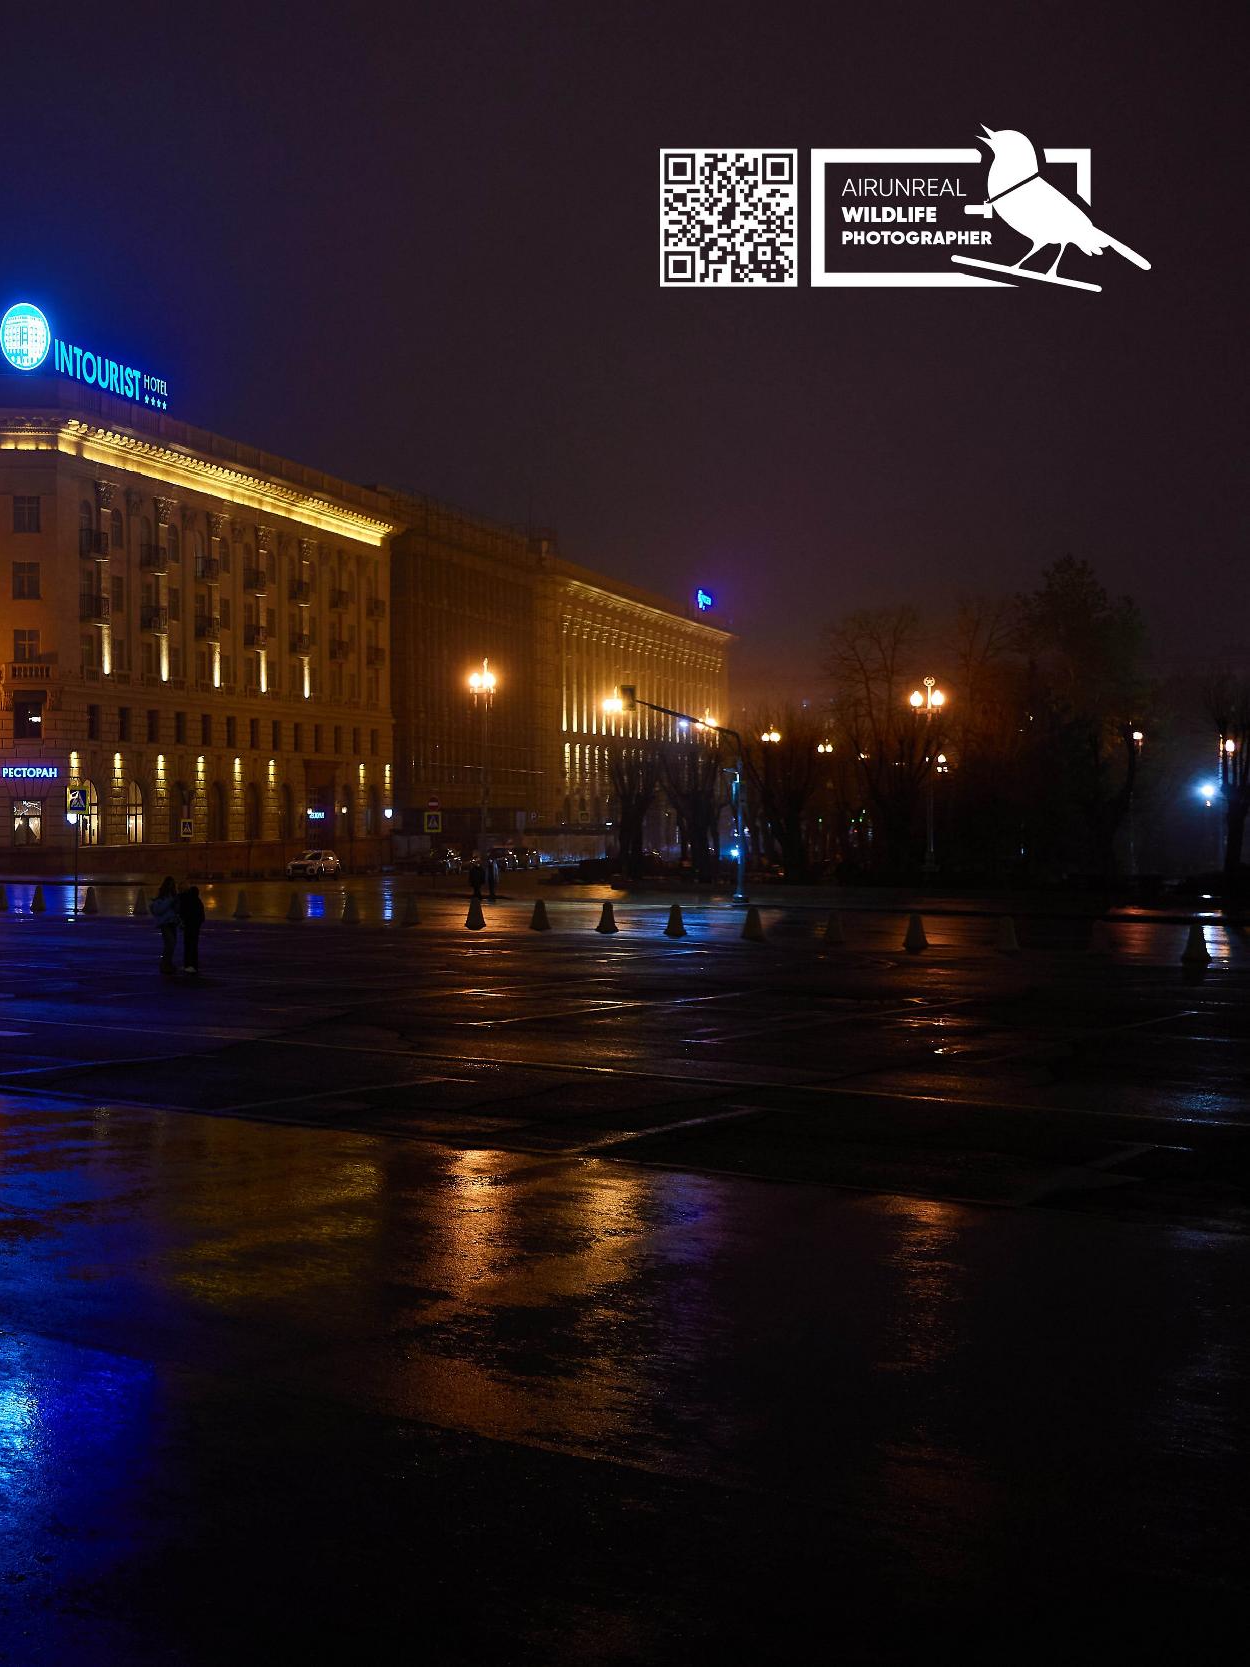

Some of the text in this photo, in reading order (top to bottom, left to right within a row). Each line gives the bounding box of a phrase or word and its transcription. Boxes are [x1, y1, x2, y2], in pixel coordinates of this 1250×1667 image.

[55, 338, 168, 401] INTOURIST HOTEL
[2, 767, 58, 778] РЕСТОРАН
